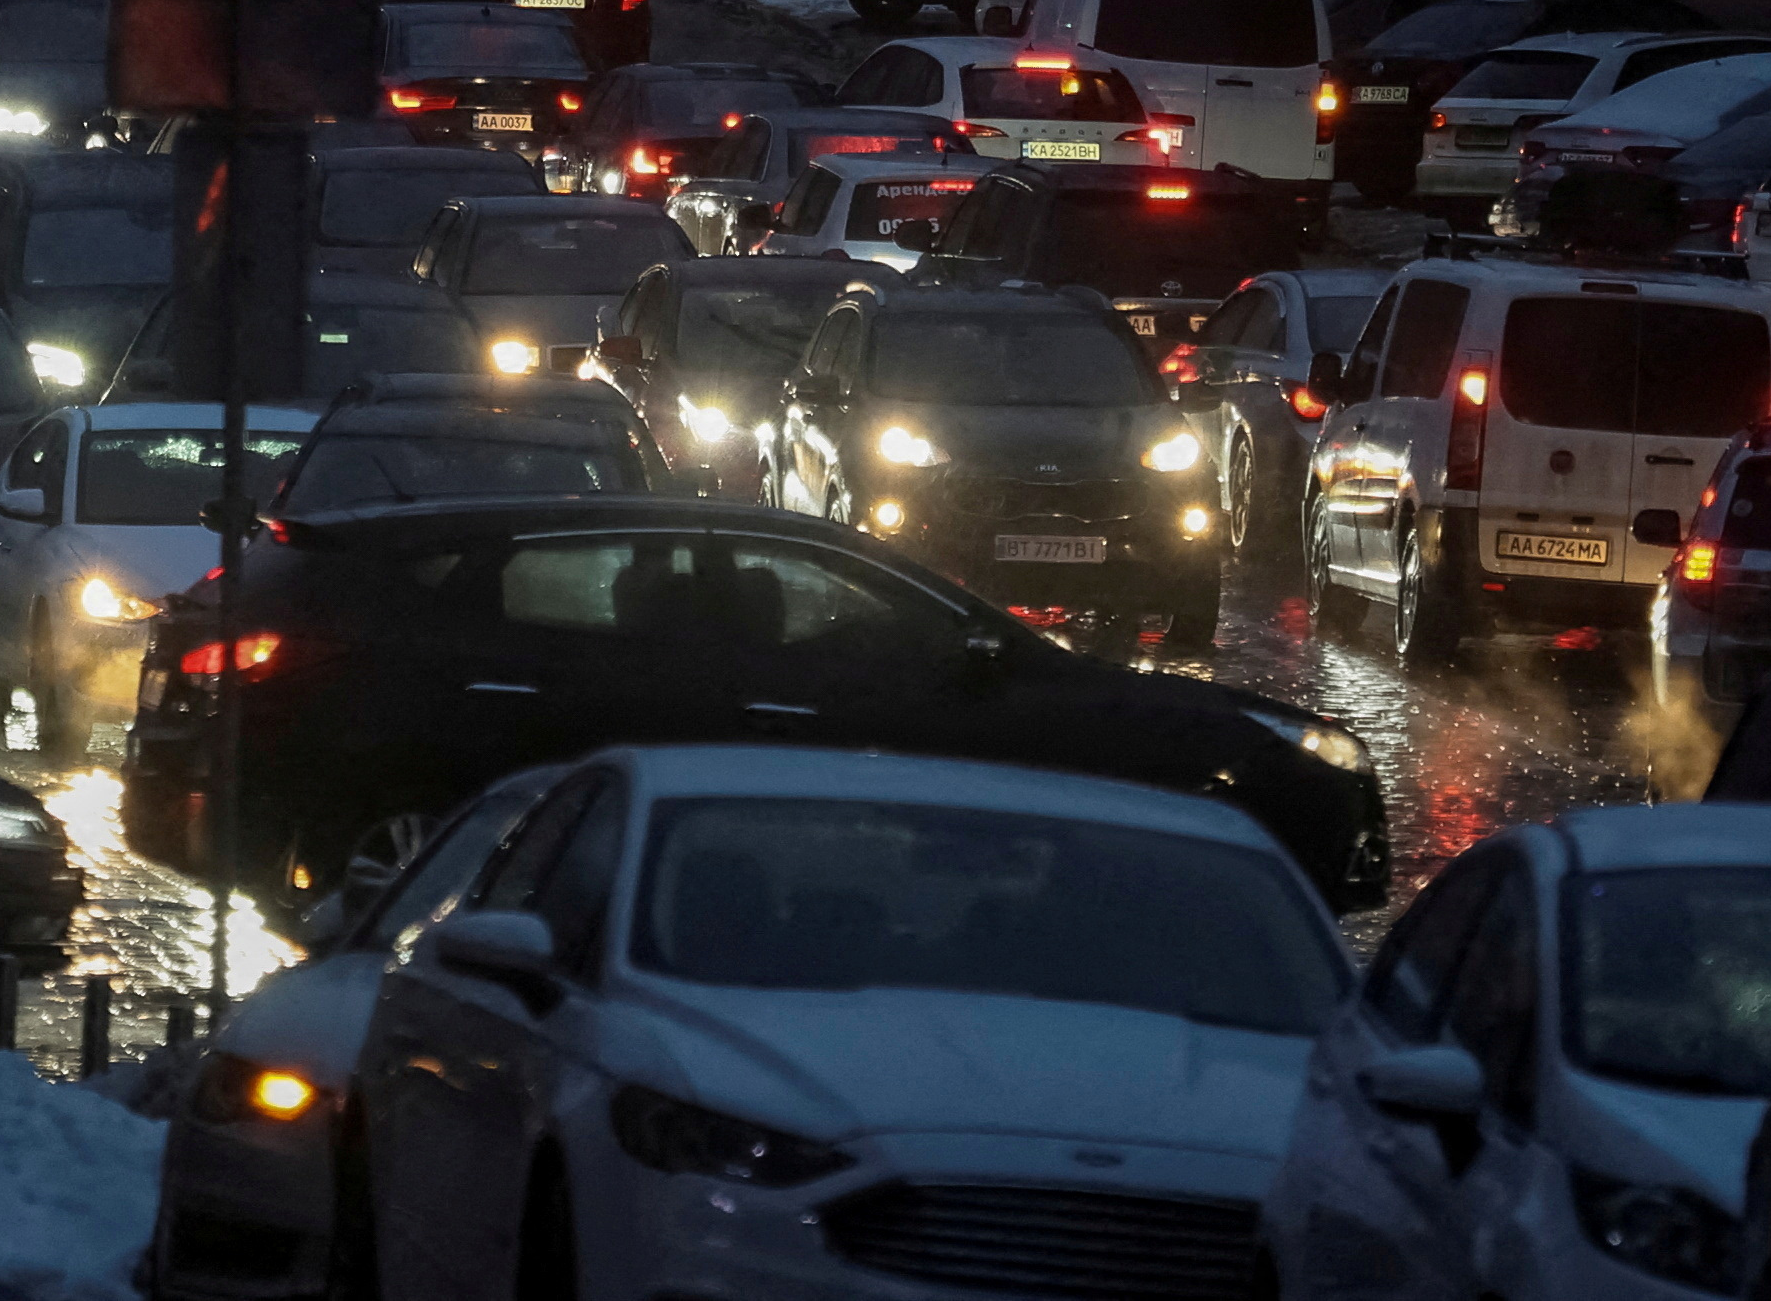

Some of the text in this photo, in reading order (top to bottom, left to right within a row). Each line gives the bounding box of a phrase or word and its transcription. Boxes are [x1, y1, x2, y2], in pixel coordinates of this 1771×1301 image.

[1393, 89, 1407, 100] CA
[480, 115, 529, 129] AA 0037
[1029, 144, 1098, 159] KA 2521 BH
[1132, 318, 1152, 333] AA
[1008, 539, 1030, 556] BT
[1033, 540, 1073, 558] 7771
[1508, 538, 1605, 563] AA 6724 MA
